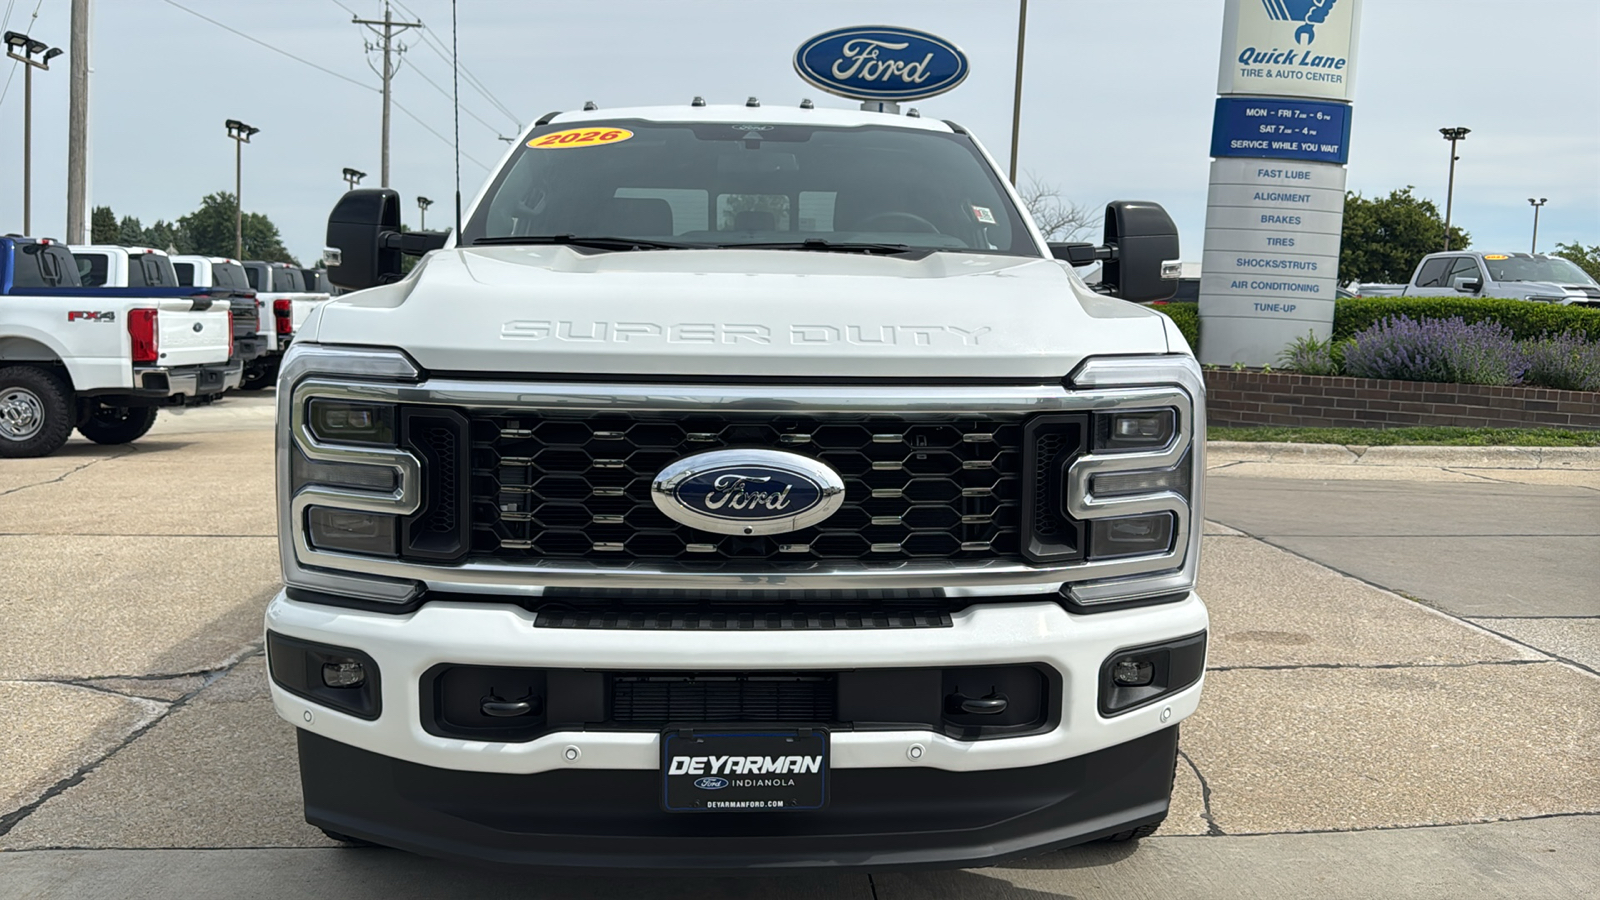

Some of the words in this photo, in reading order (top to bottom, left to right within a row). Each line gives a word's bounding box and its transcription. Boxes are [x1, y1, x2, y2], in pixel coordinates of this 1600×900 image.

[832, 38, 934, 84] Ford
[1238, 47, 1298, 66] Quick
[1298, 50, 1346, 70] Lane
[1240, 68, 1264, 78] TIRE
[1265, 69, 1273, 78] &
[1275, 70, 1303, 80] AUTO
[1305, 71, 1343, 83] CENTER
[1245, 108, 1267, 117] MON
[1278, 109, 1292, 118] FRI
[1259, 124, 1276, 133] SAT
[536, 129, 622, 147] 2026
[1230, 140, 1269, 148] SERVICE
[1272, 141, 1298, 150] WHILE
[1301, 143, 1318, 152] YOU
[1320, 144, 1339, 153] WAIT
[1257, 169, 1283, 178] FAST
[1285, 170, 1311, 180] LUBE
[1253, 192, 1311, 203] ALIGNMENT
[1260, 215, 1301, 225] BRAKES
[1266, 237, 1295, 247] TIRES
[1236, 258, 1318, 271] SHOCKS/STRUTS
[1231, 280, 1248, 289] AIR
[1250, 281, 1320, 293] CONDITIONING
[1253, 303, 1296, 312] TUNE-UP
[68, 310, 115, 322] FX4
[499, 320, 771, 345] SUPER
[789, 324, 992, 346] DUTY
[705, 474, 793, 510] Ford
[668, 755, 823, 776] DEYARMAN
[700, 778, 722, 788] Ford
[732, 778, 795, 787] INDIANOLA
[707, 800, 784, 808] DEYARMANFORD.COM
